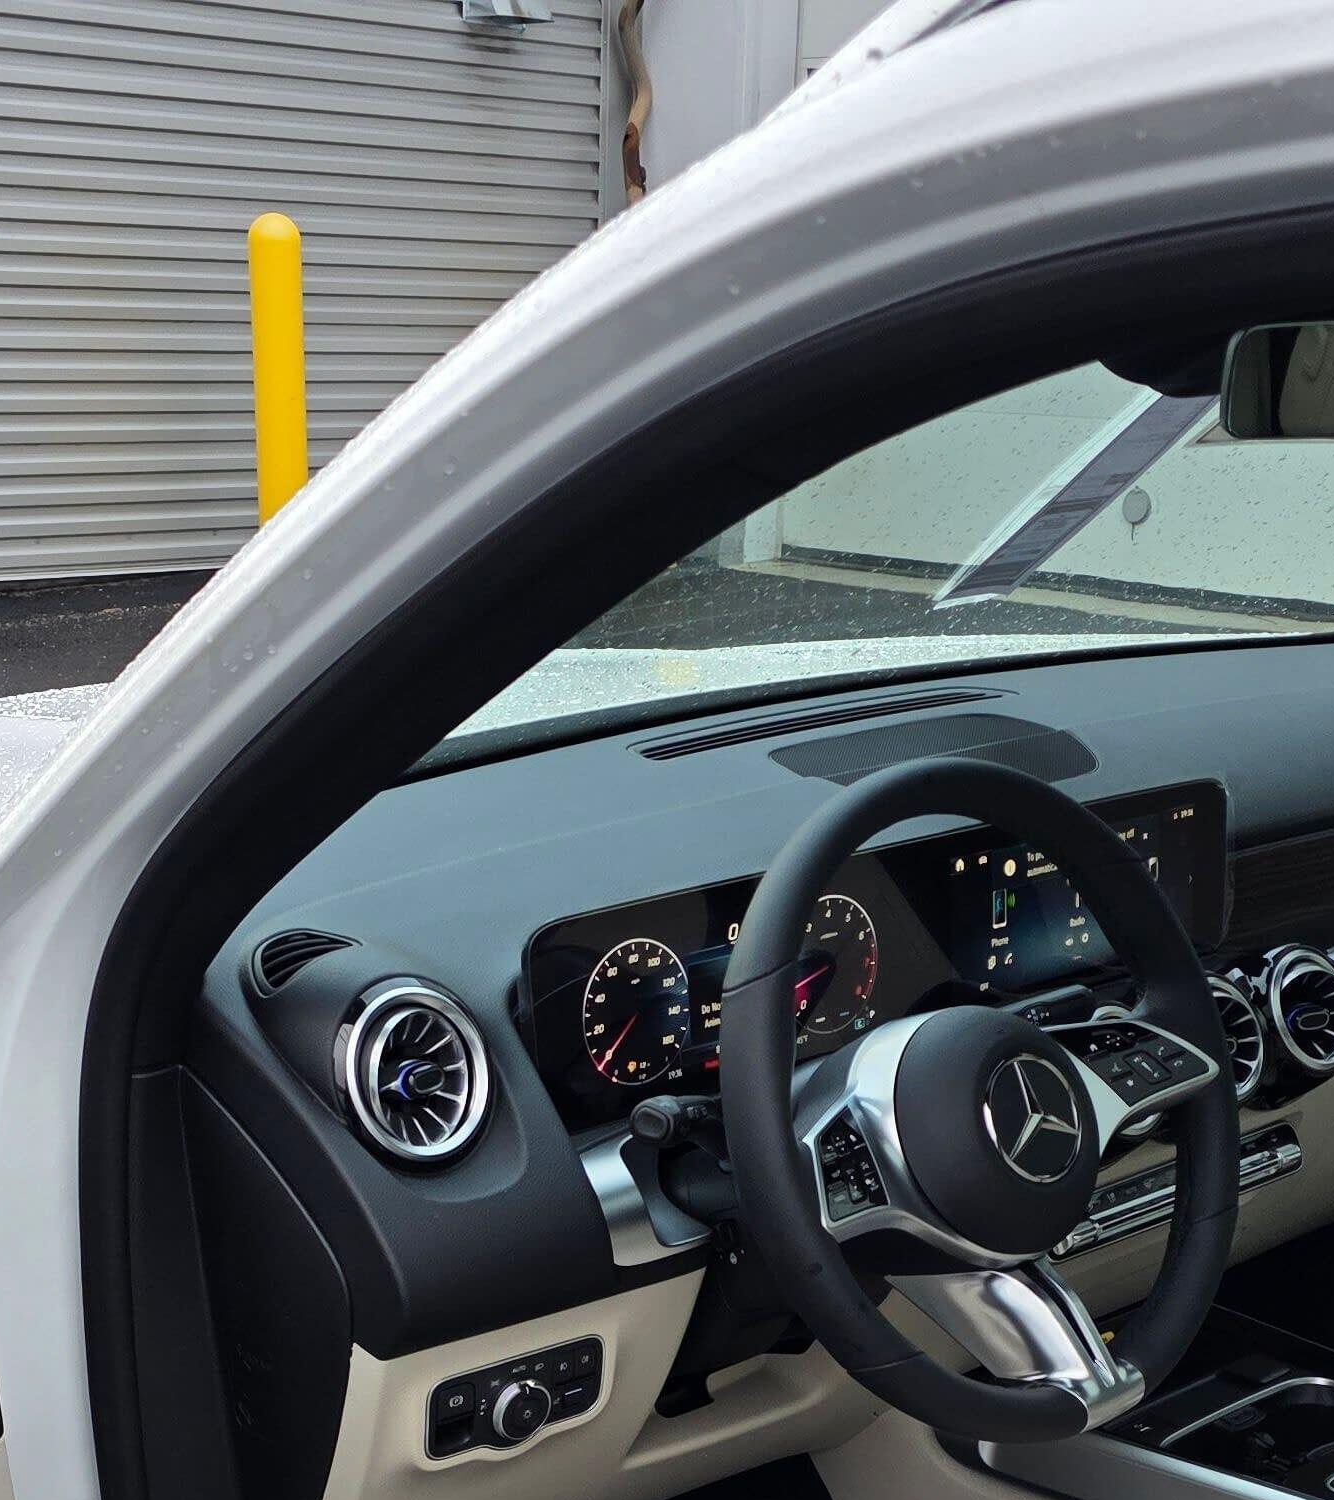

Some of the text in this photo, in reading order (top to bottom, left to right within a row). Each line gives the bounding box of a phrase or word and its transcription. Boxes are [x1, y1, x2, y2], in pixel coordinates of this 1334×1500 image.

[825, 909, 832, 918] 4
[845, 911, 851, 922] 5
[728, 923, 739, 941] 0
[805, 923, 812, 932] 3
[858, 930, 865, 940] 6
[991, 936, 1009, 948] Phone
[663, 977, 675, 987] 120
[701, 1005, 710, 1014] Do
[800, 1000, 807, 1010] 0
[668, 1005, 681, 1016] 140
[869, 1010, 875, 1019] P
[594, 1024, 605, 1035] 20
